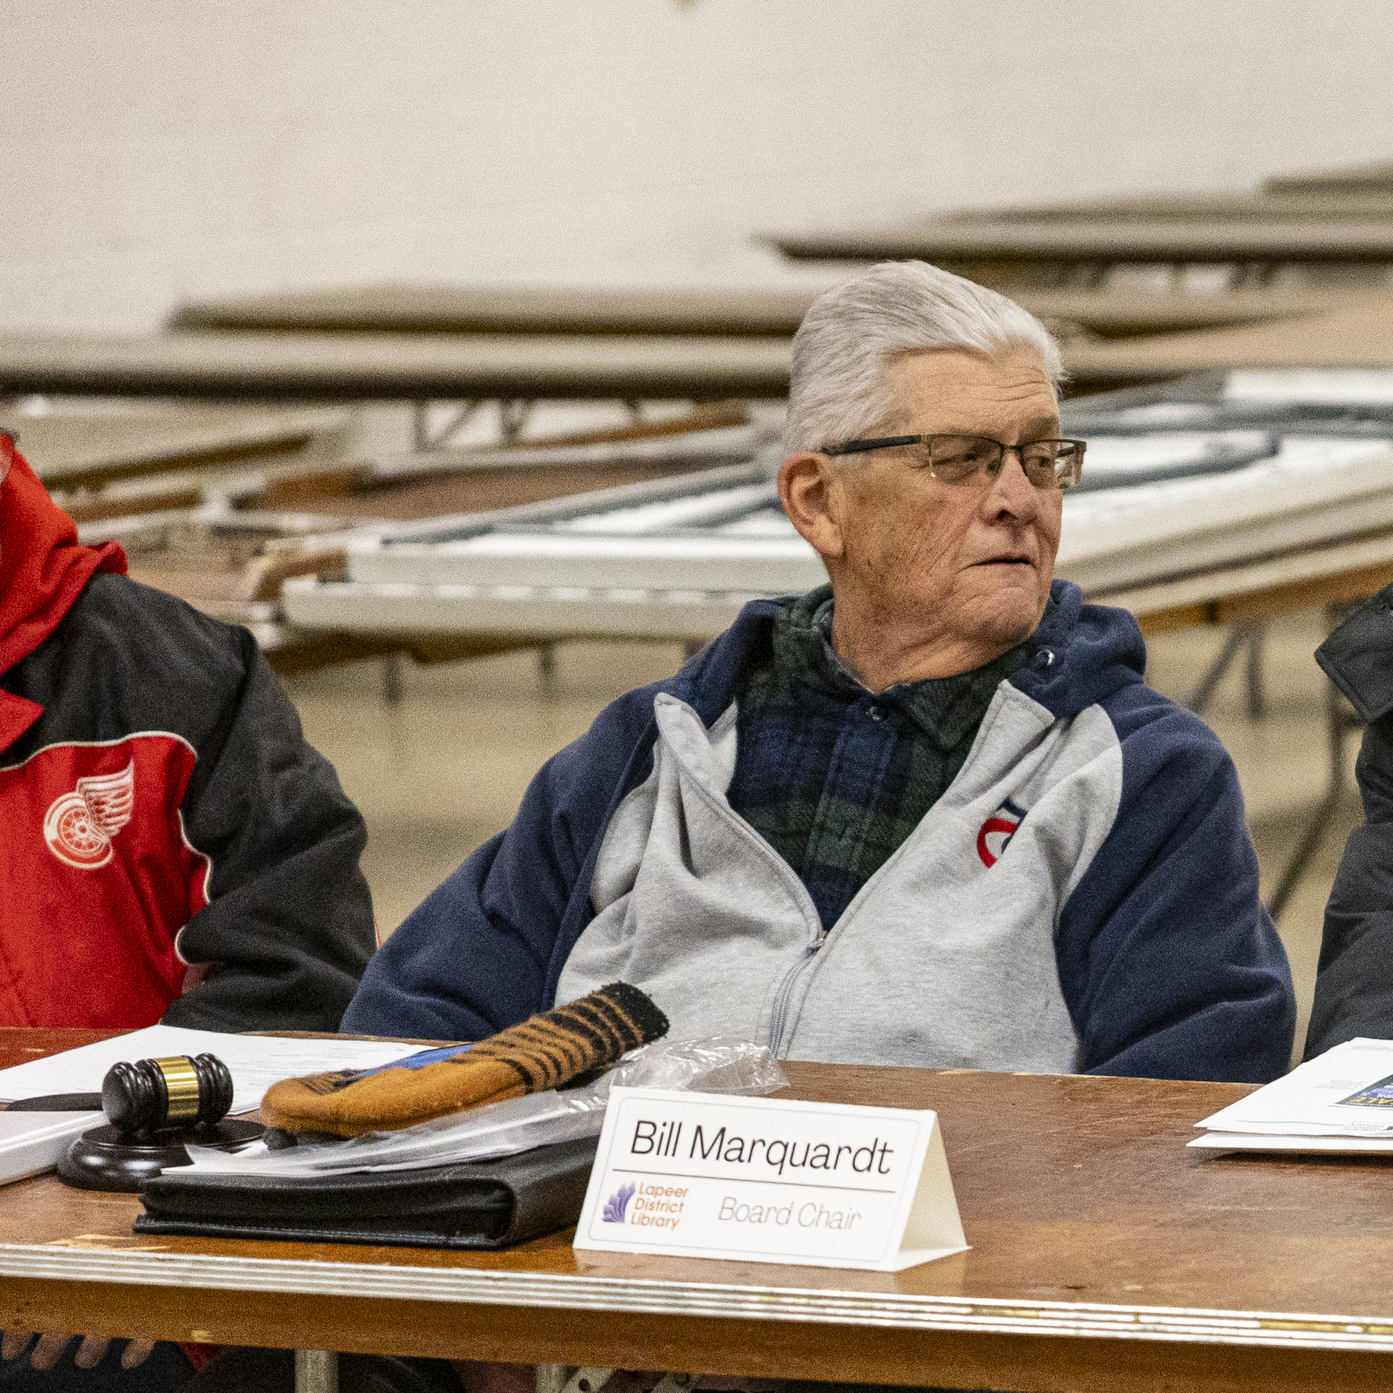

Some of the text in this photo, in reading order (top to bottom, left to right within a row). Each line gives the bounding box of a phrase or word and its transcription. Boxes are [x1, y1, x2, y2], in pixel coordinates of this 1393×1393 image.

[630, 1119, 894, 1176] Bill Marquardt
[638, 1181, 689, 1200] Lapeer
[634, 1197, 684, 1214] District
[718, 1196, 862, 1231] Board Chair
[630, 1213, 679, 1232] Library
